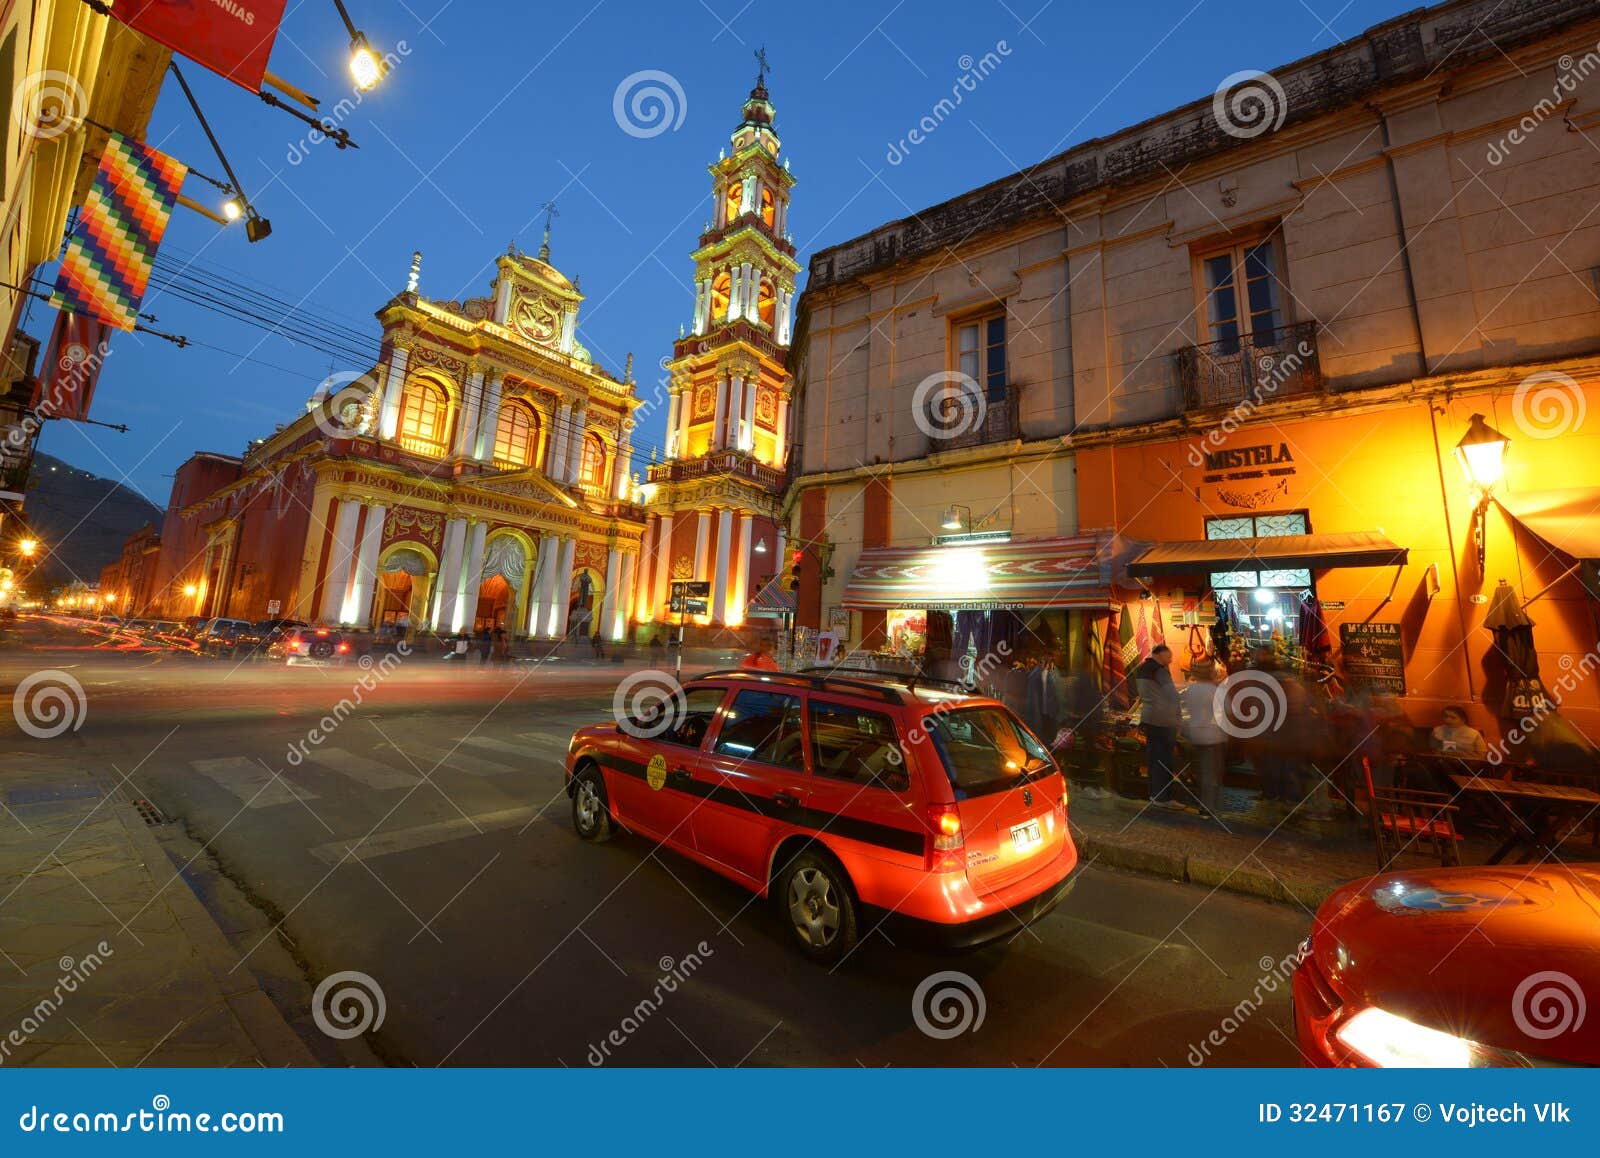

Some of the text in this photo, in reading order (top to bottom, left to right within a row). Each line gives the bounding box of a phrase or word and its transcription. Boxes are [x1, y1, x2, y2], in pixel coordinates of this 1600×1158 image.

[1205, 443, 1294, 471] MISTELA
[901, 602, 957, 610] Artesanias
[980, 601, 1025, 611] Milagro
